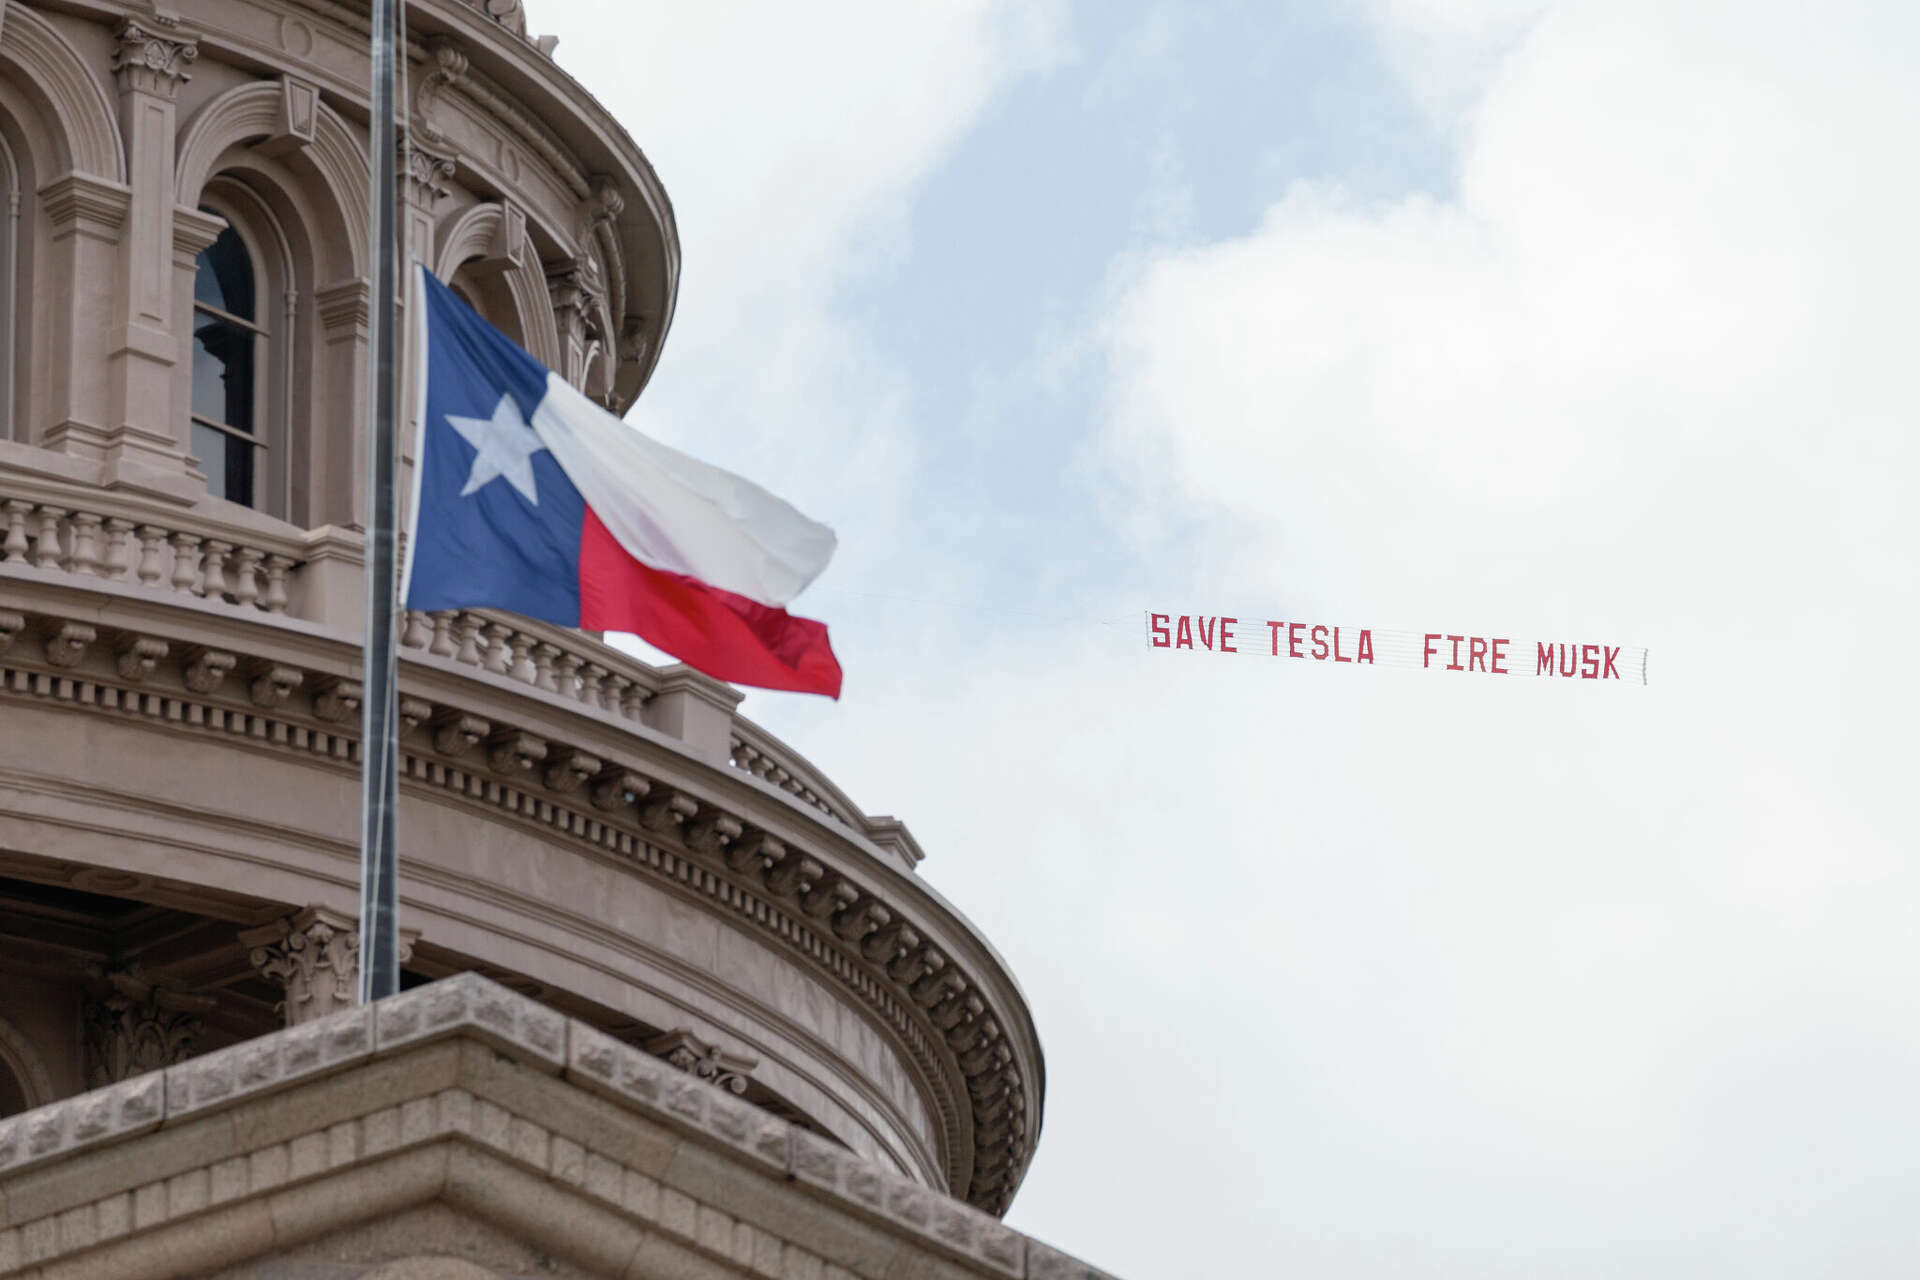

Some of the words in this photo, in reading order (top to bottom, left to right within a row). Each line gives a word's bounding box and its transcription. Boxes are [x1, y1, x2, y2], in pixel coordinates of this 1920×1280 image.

[1151, 613, 1238, 653] SAVE
[1266, 620, 1374, 665] TESLA
[1423, 633, 1510, 675] FIRE
[1536, 641, 1620, 680] MUSK
